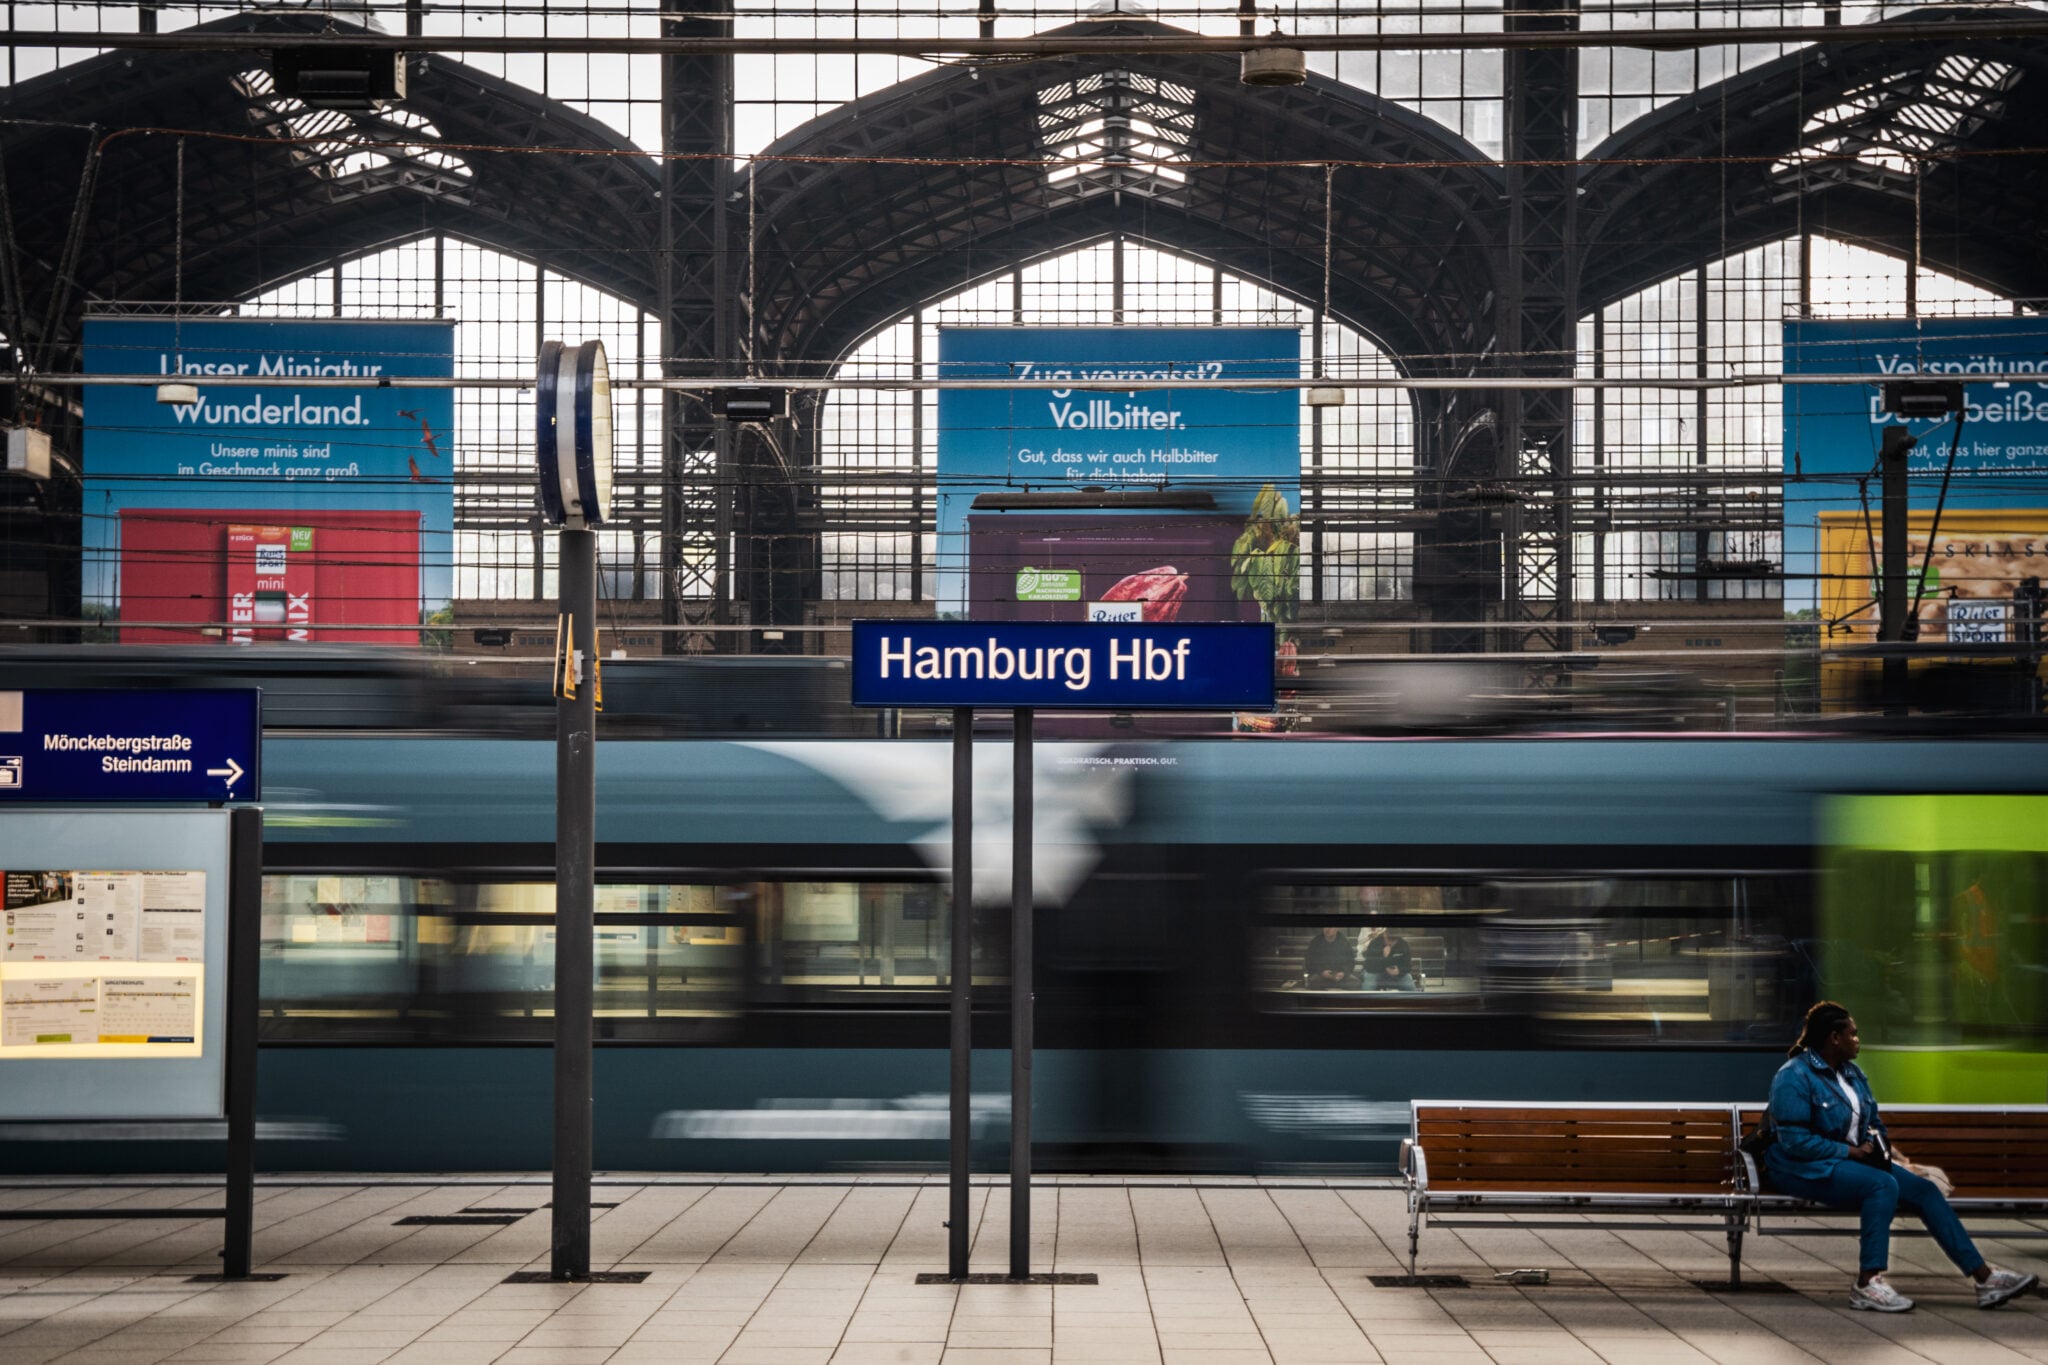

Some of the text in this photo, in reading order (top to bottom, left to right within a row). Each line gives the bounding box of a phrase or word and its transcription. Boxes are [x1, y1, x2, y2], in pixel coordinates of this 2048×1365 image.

[160, 354, 383, 377] Unser Miniatur
[1013, 361, 1223, 398] Zug verpasst?
[172, 393, 370, 425] Wunderland.
[1048, 399, 1186, 430] Vollbitter.
[211, 443, 331, 458] Unsere minis sind
[1017, 447, 1219, 465] Gut, dass wir auch Halbbitter
[1973, 441, 2001, 457] hier
[177, 463, 194, 476] im
[199, 462, 282, 477] Geschmack
[285, 466, 321, 481] ganz
[1066, 467, 1085, 482] für
[1089, 467, 1118, 482] dich
[292, 530, 311, 541] NEU
[256, 576, 285, 590] mini
[880, 637, 1191, 690] Hamburg Hbf
[43, 733, 193, 754] Mönckebergstraße
[102, 755, 193, 773] Steindamm
[1113, 756, 1160, 766] PRAKTISCH.
[1160, 757, 1179, 766] GUT.
